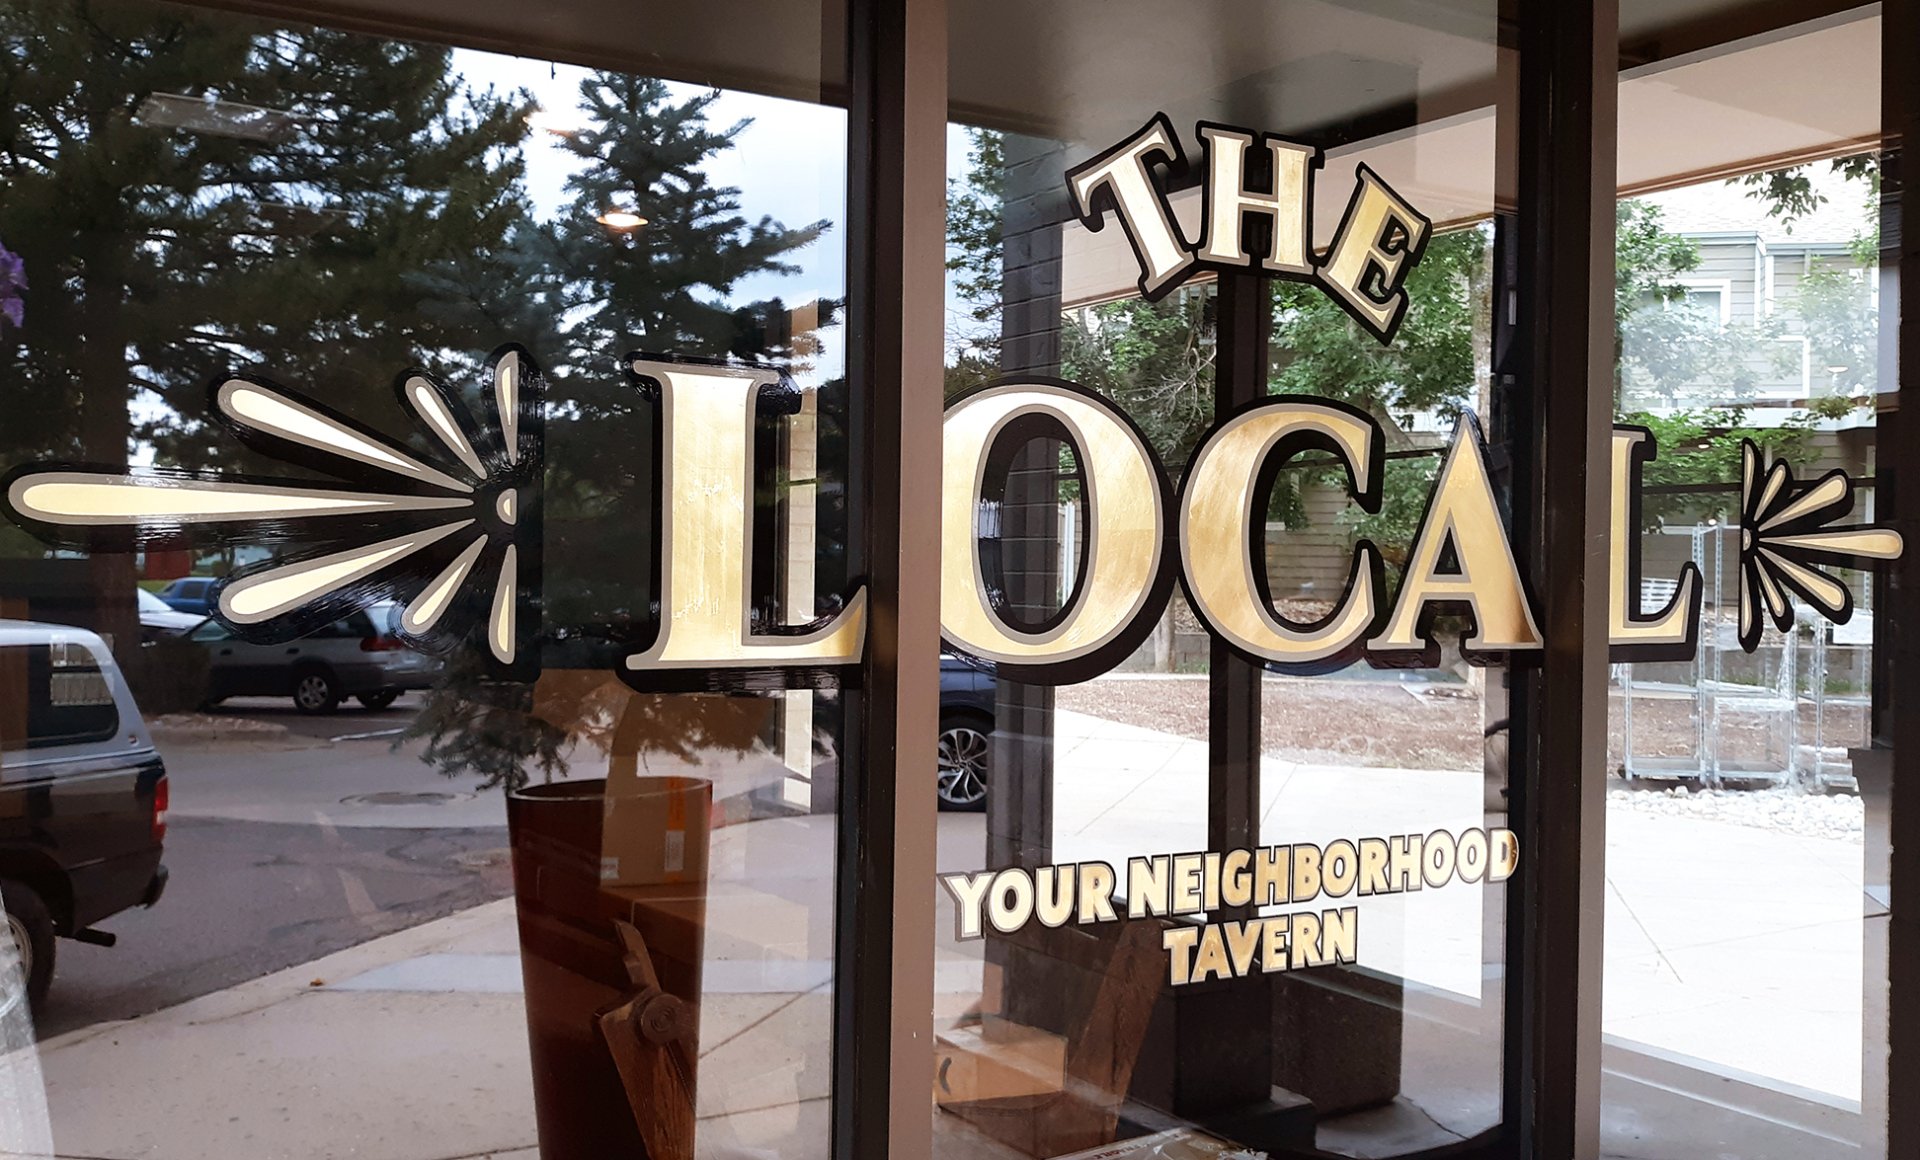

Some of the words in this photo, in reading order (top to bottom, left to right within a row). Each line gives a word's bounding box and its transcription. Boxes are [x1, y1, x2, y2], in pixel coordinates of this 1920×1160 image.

[1067, 114, 1430, 342] THE
[626, 358, 1698, 672] LOCAL
[940, 860, 1118, 941] YOUR
[1128, 827, 1519, 919] NEIGHBORHOOD
[1162, 906, 1357, 986] TAVERN
